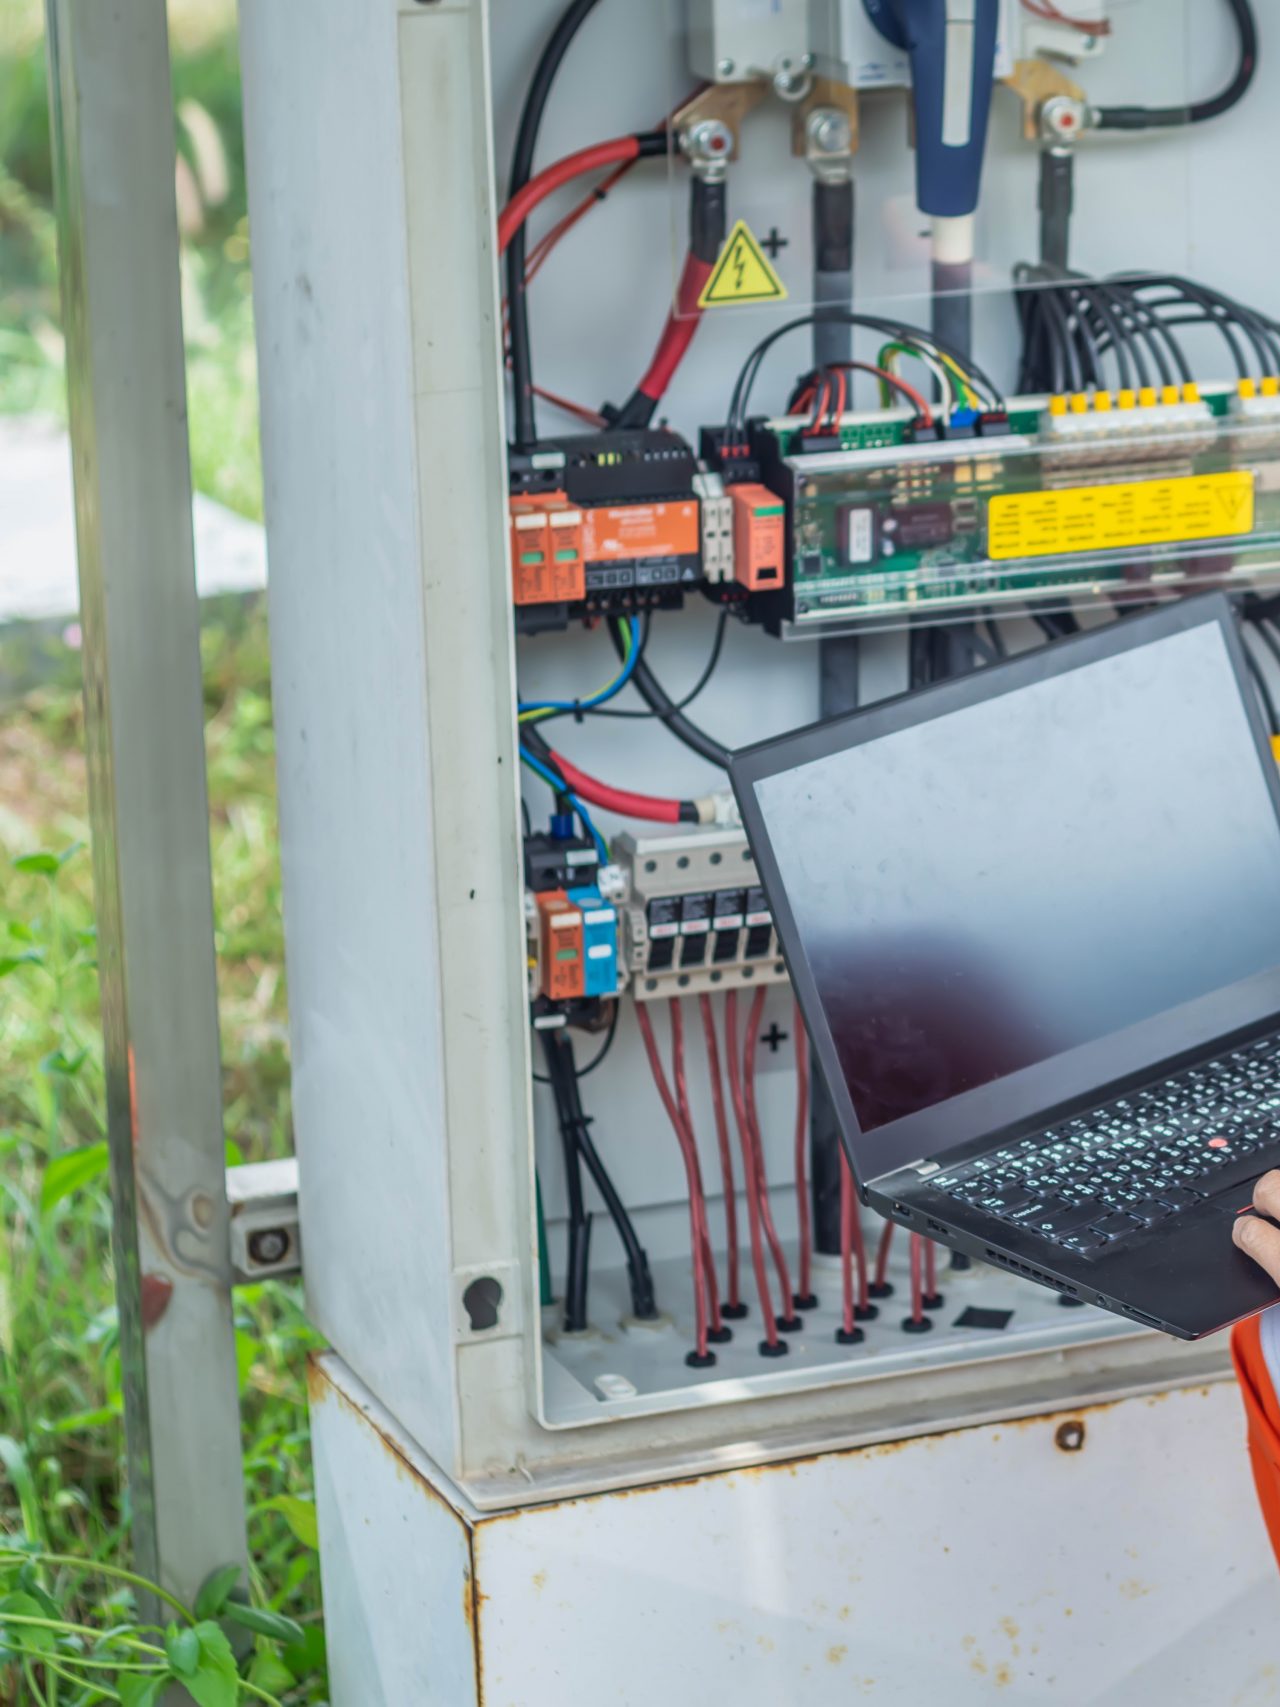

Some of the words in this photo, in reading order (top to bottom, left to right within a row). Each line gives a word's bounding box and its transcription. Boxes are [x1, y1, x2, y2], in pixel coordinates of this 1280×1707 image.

[1055, 1166, 1070, 1174] W
[1062, 1188, 1074, 1196] A
[1103, 1194, 1116, 1202] Z
